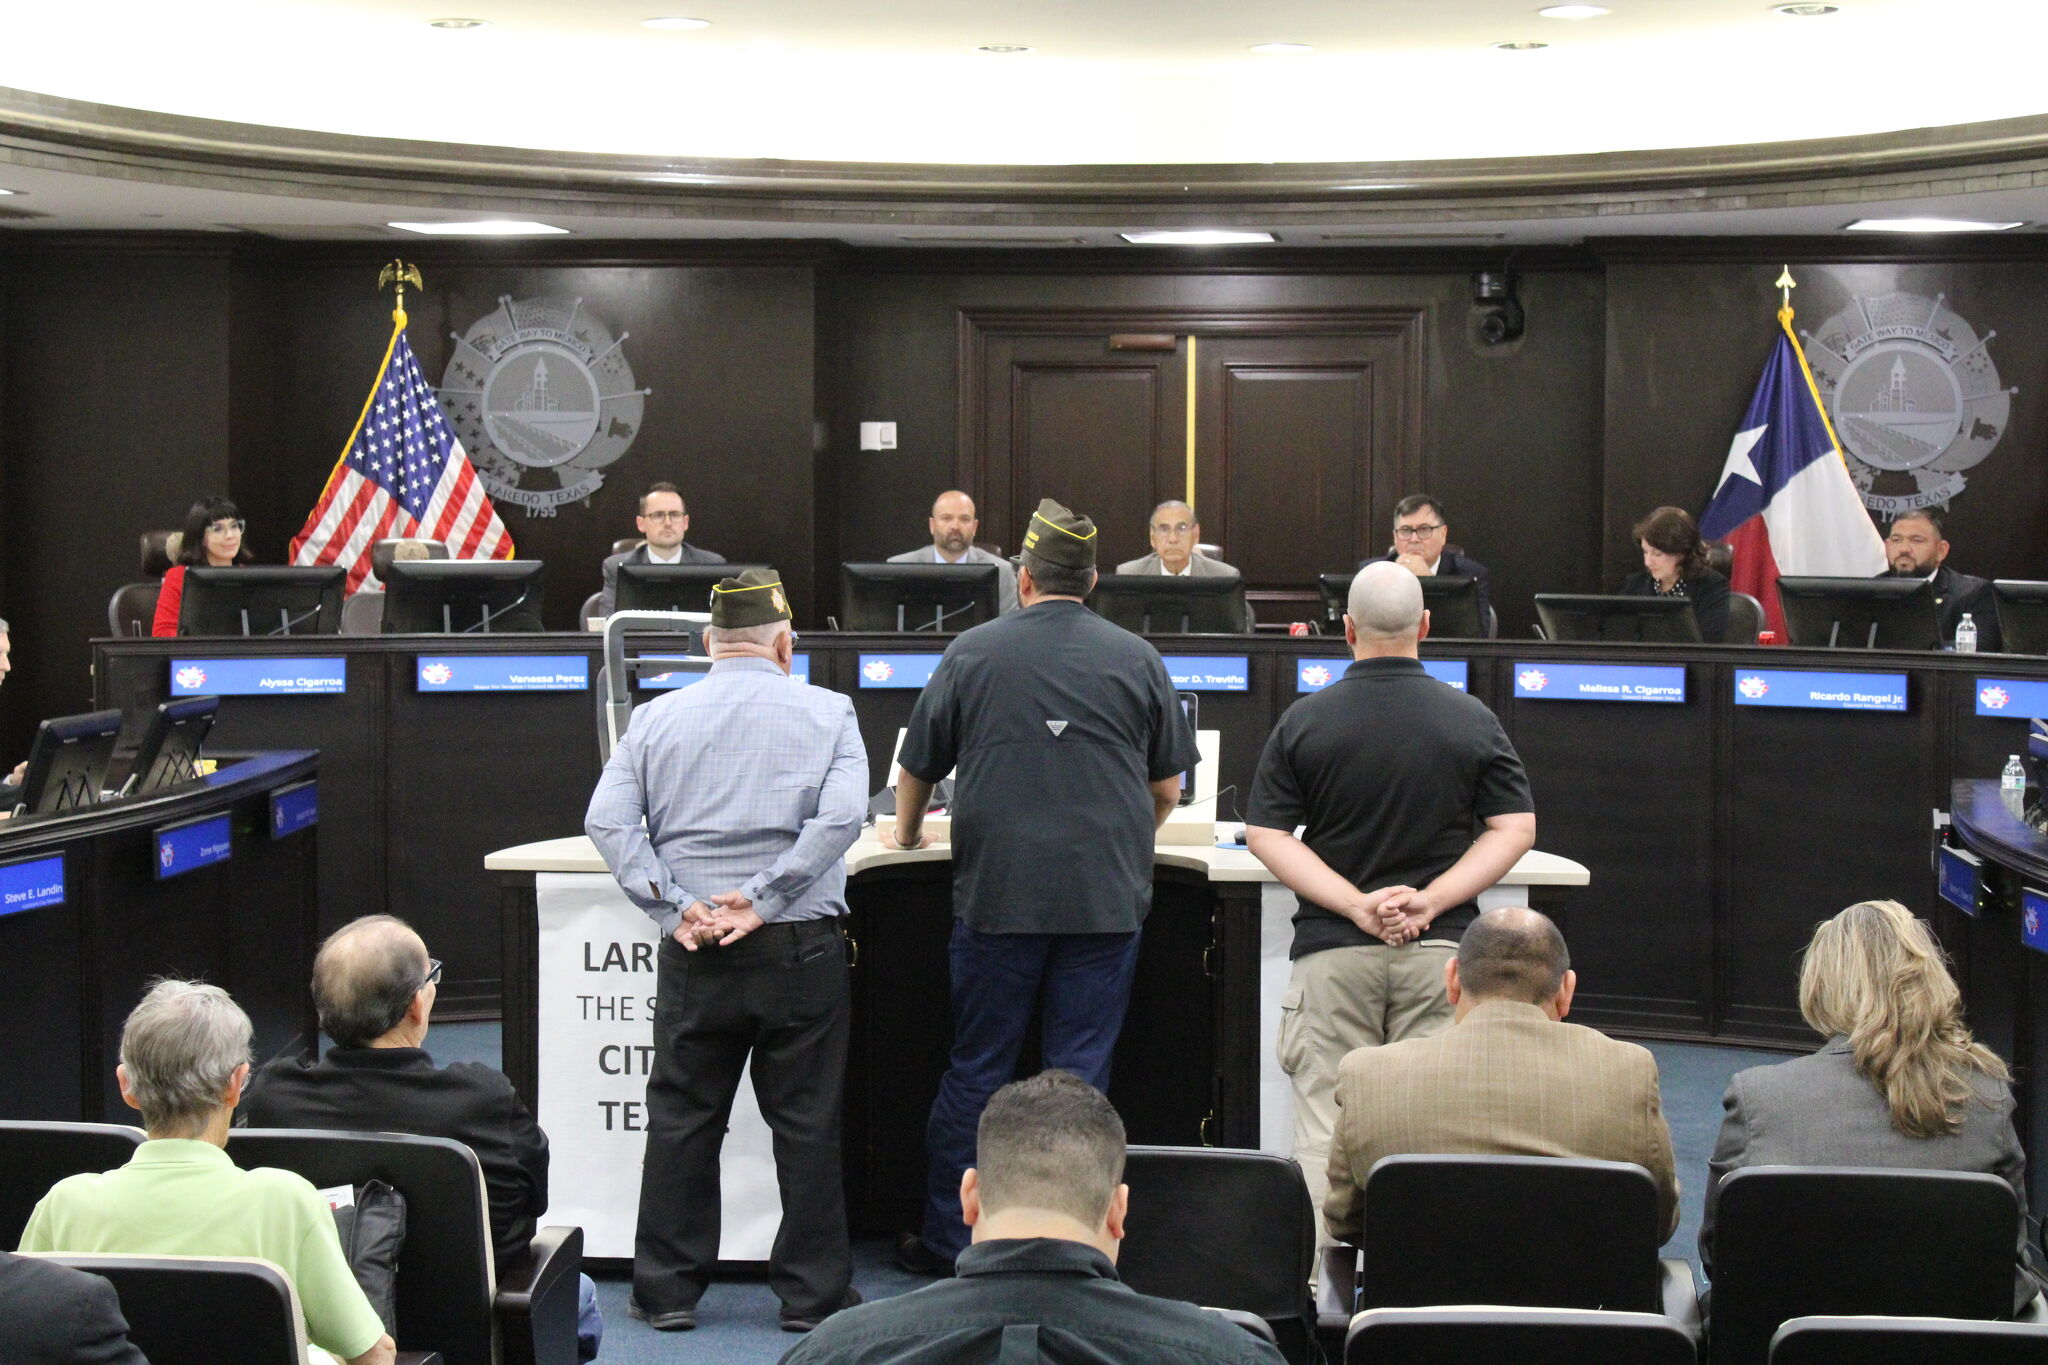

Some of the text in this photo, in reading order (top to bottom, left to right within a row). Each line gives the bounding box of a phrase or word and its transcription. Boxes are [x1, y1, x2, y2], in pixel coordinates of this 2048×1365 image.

[540, 329, 553, 338] TO
[1875, 327, 1898, 337] WAY
[1901, 327, 1914, 336] TO
[486, 482, 591, 504] LAREDO TEXAS
[1905, 486, 1951, 509] TEXAS
[526, 505, 557, 518] 1755
[259, 677, 343, 688] Alyssa Cigarroa
[509, 674, 586, 684] Vanessa Perez
[1191, 674, 1203, 684] D.
[1204, 674, 1245, 684] Treviño
[1579, 684, 1682, 696] Melissa R. Cigarroa
[1810, 691, 1904, 705] Ricardo Rangel Jr.
[5, 893, 27, 904] Steve
[28, 889, 36, 900] E.
[37, 884, 63, 898] Landin
[584, 941, 655, 973] LAR
[576, 995, 635, 1021] THE
[598, 1044, 656, 1076] CIT
